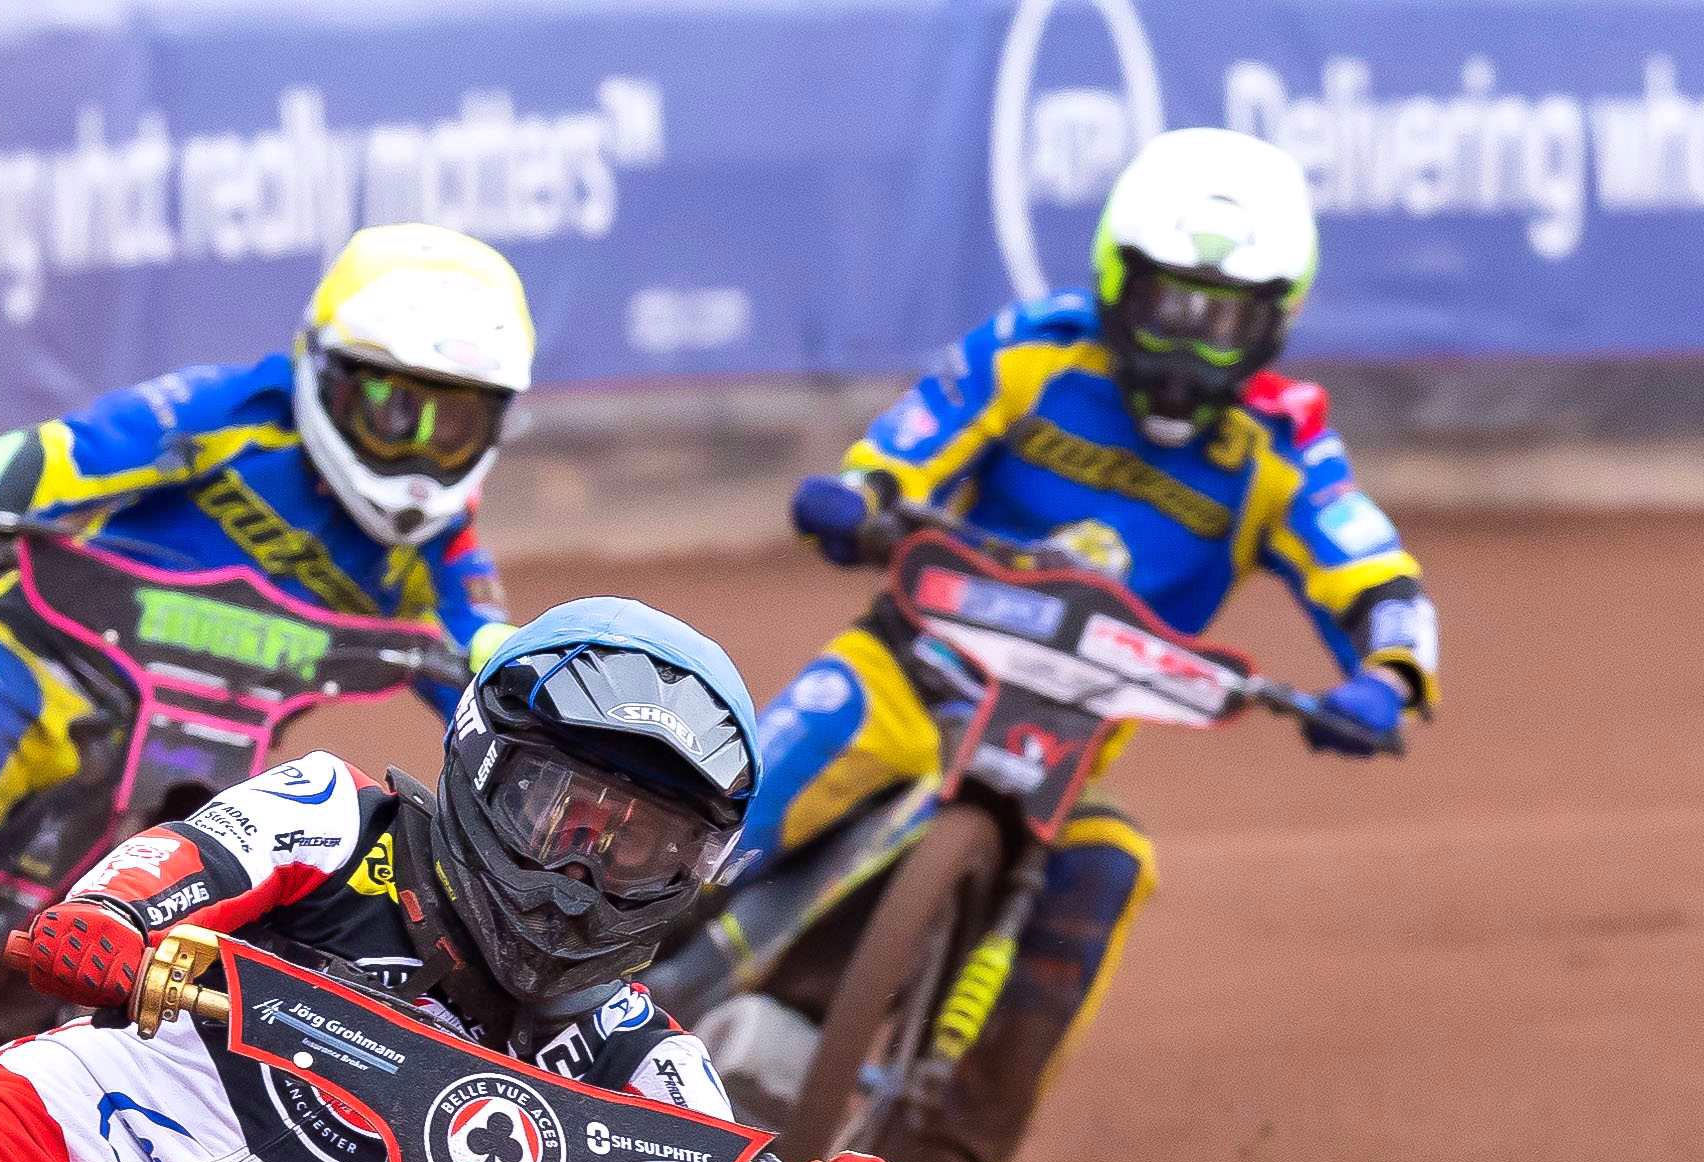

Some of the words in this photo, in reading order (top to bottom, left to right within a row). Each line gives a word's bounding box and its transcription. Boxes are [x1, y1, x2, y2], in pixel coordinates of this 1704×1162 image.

[622, 705, 696, 748] SHOEI
[473, 739, 498, 791] LEATT
[288, 1002, 326, 1029] Jörg
[325, 1019, 407, 1065] Grohmann
[440, 1081, 489, 1115] BELLE
[495, 1081, 531, 1107] VUE
[530, 1108, 559, 1149] ACES
[611, 1134, 633, 1151] SH
